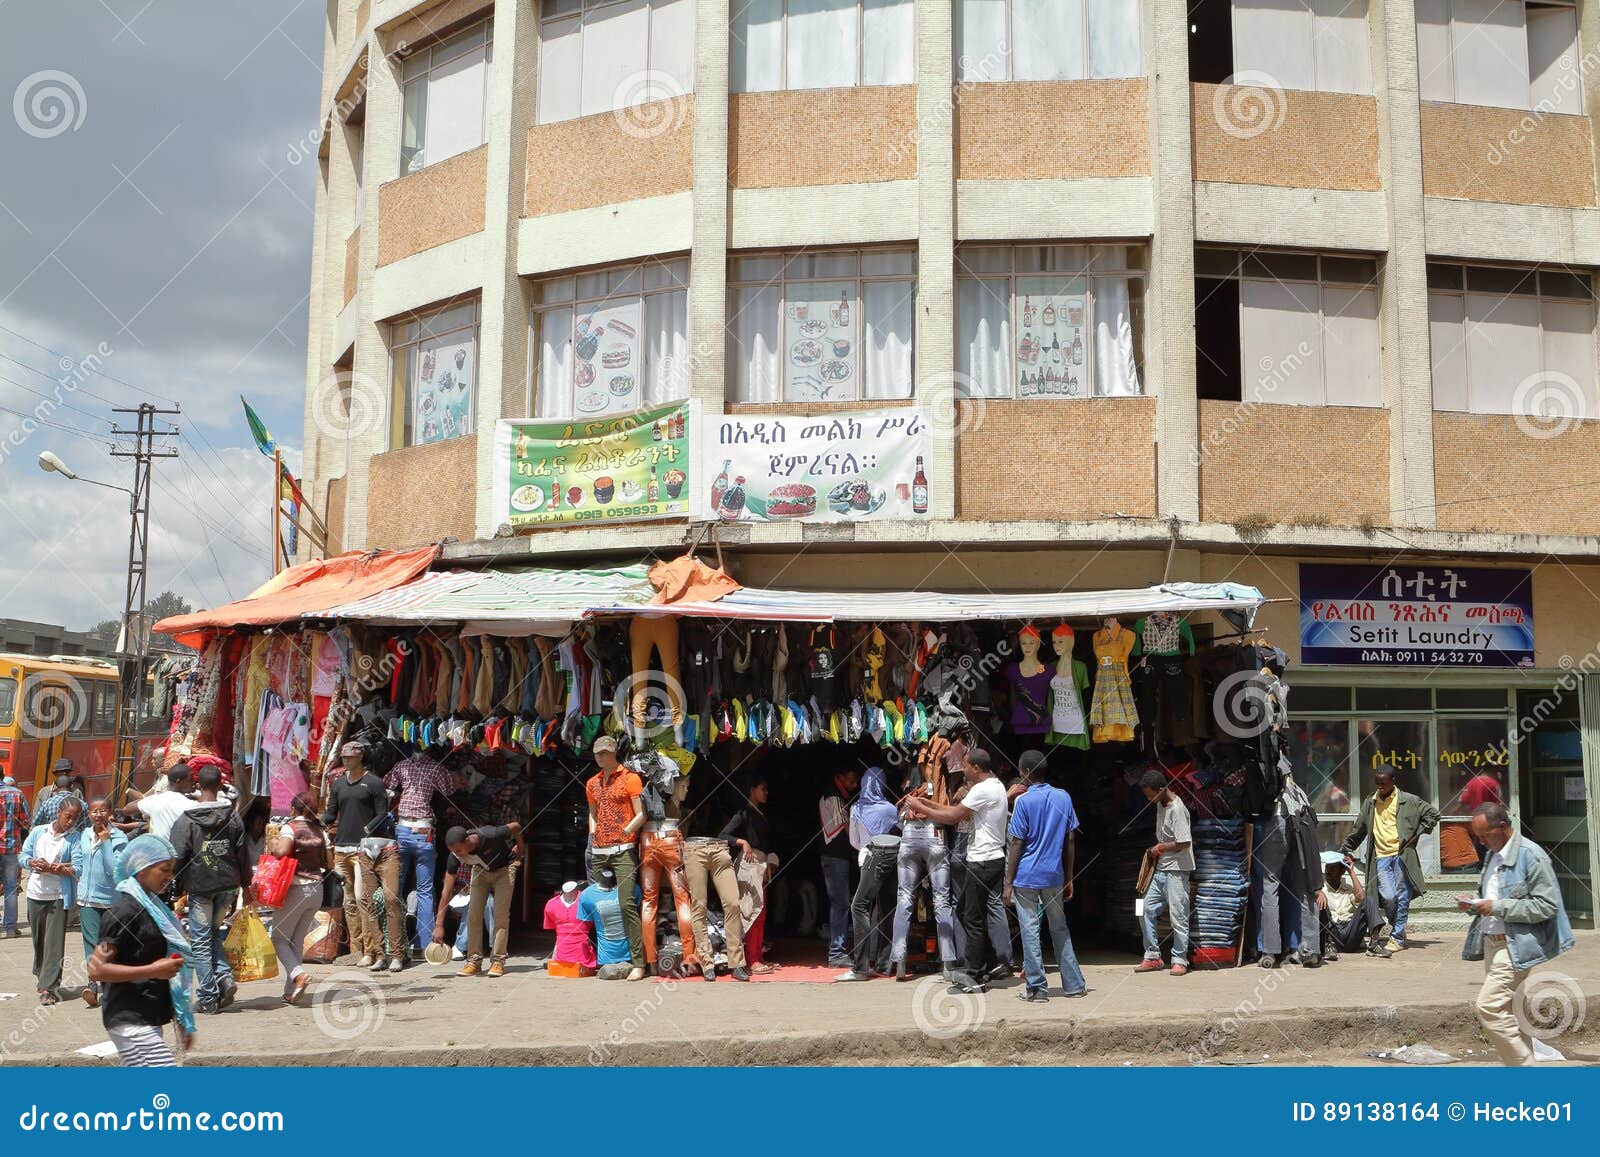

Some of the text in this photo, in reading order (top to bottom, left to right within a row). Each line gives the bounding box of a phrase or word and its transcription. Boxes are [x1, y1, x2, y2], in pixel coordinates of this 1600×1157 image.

[720, 421, 786, 445] በአዲስ
[800, 418, 862, 441] መልክ
[574, 509, 603, 520] 0913
[607, 505, 658, 518] 059893
[1312, 602, 1375, 622] የልብስ
[1350, 626, 1493, 649] Setit Laundry
[1396, 651, 1425, 662] 0911
